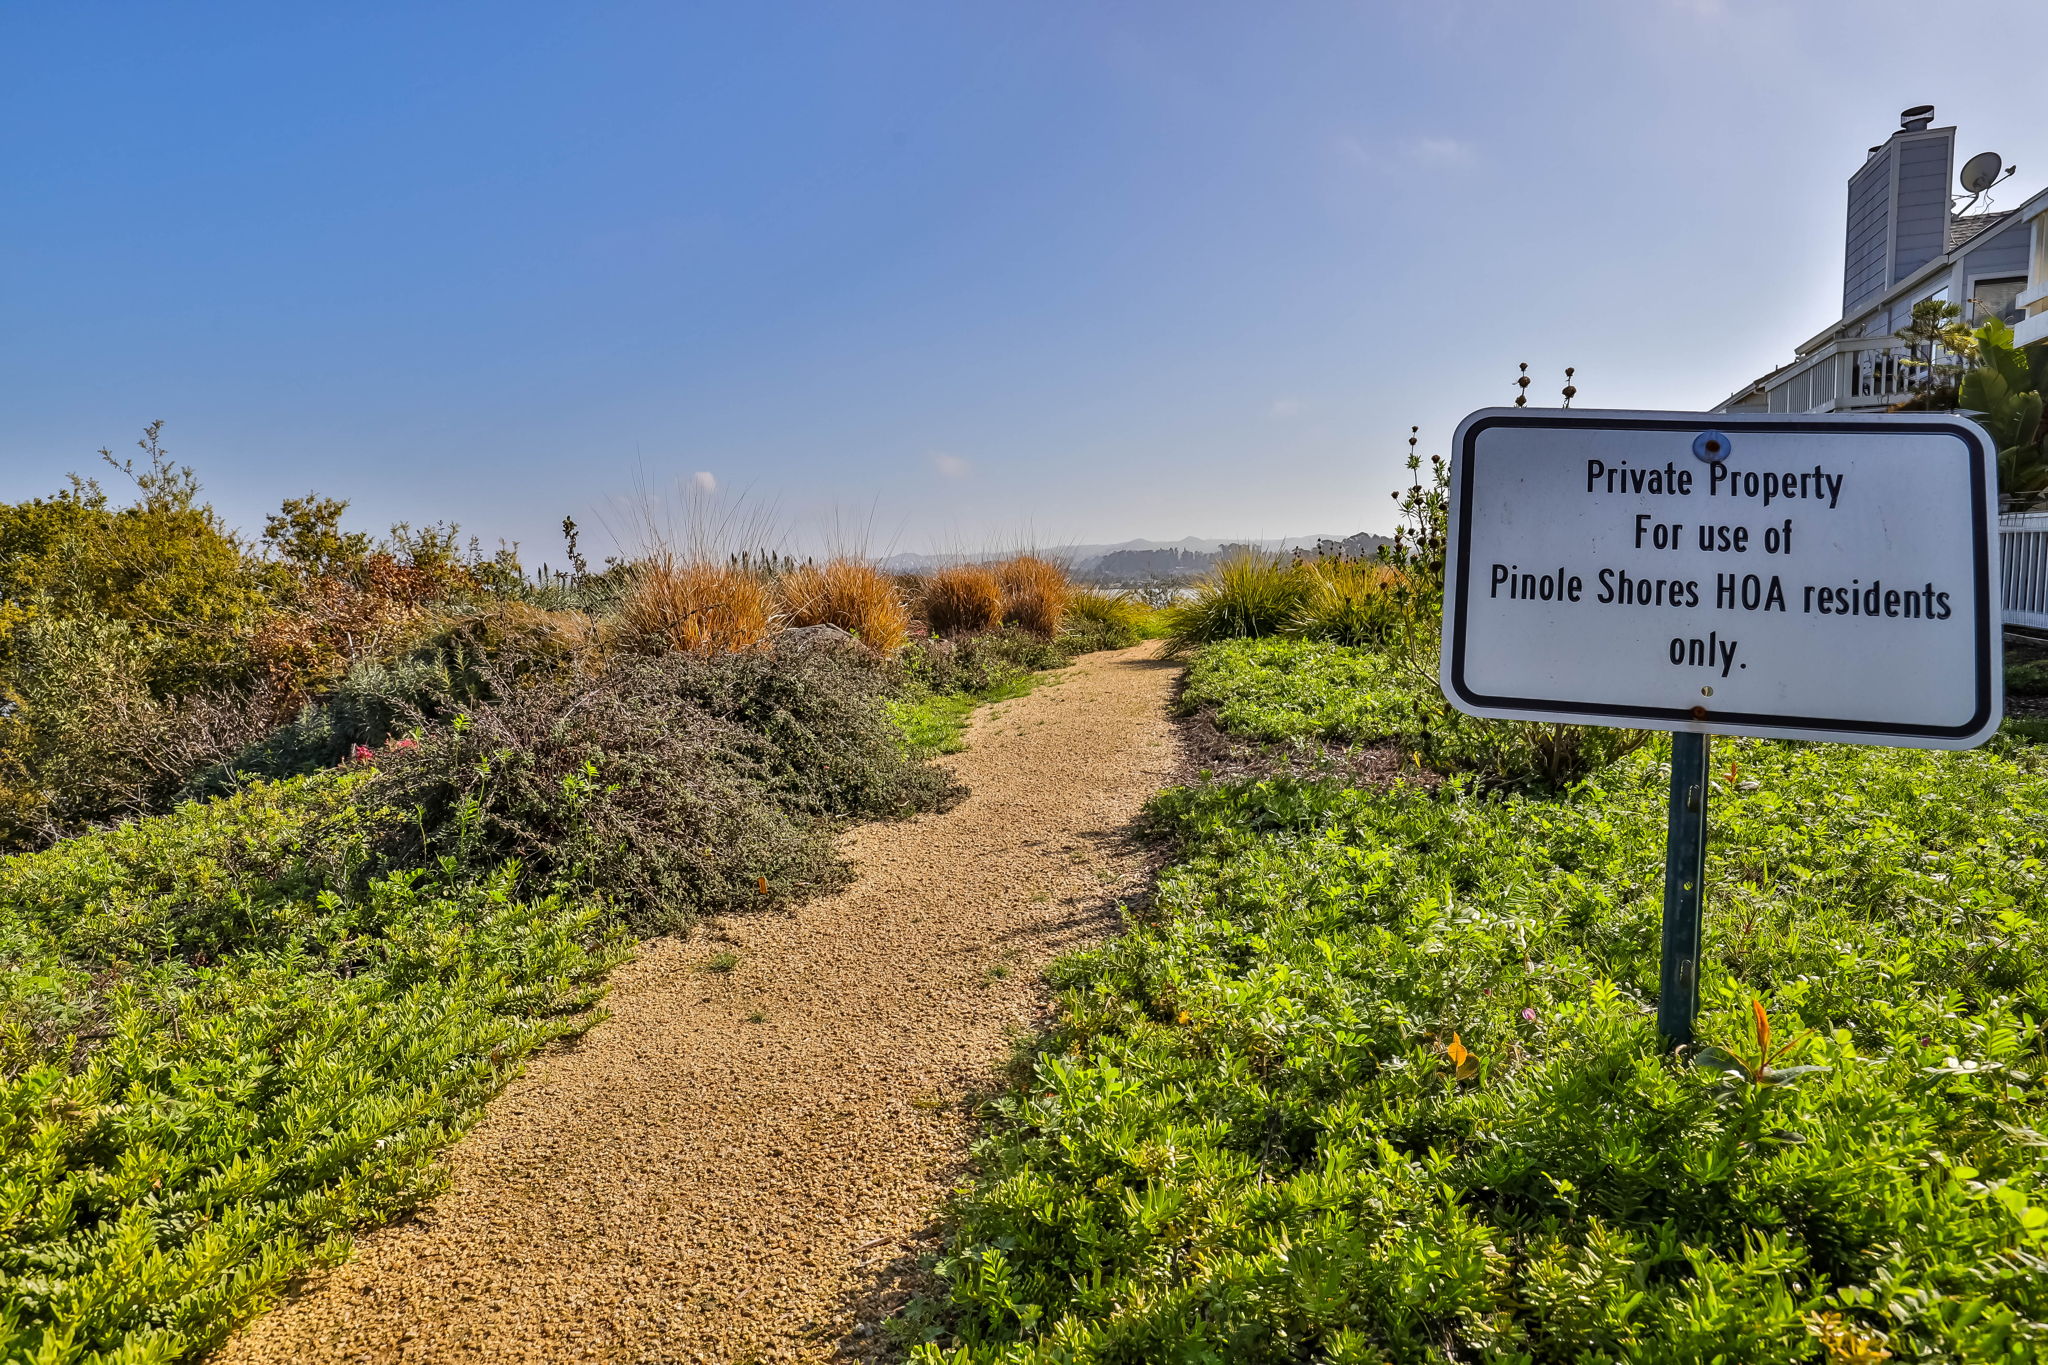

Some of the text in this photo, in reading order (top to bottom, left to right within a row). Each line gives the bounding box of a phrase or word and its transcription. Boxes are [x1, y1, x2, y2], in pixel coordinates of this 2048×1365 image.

[1586, 459, 1844, 509] Private Property
[1634, 514, 1793, 555] For use of
[1490, 563, 1952, 621] Pinole Shores HOA residents
[1669, 630, 1747, 679] only.
